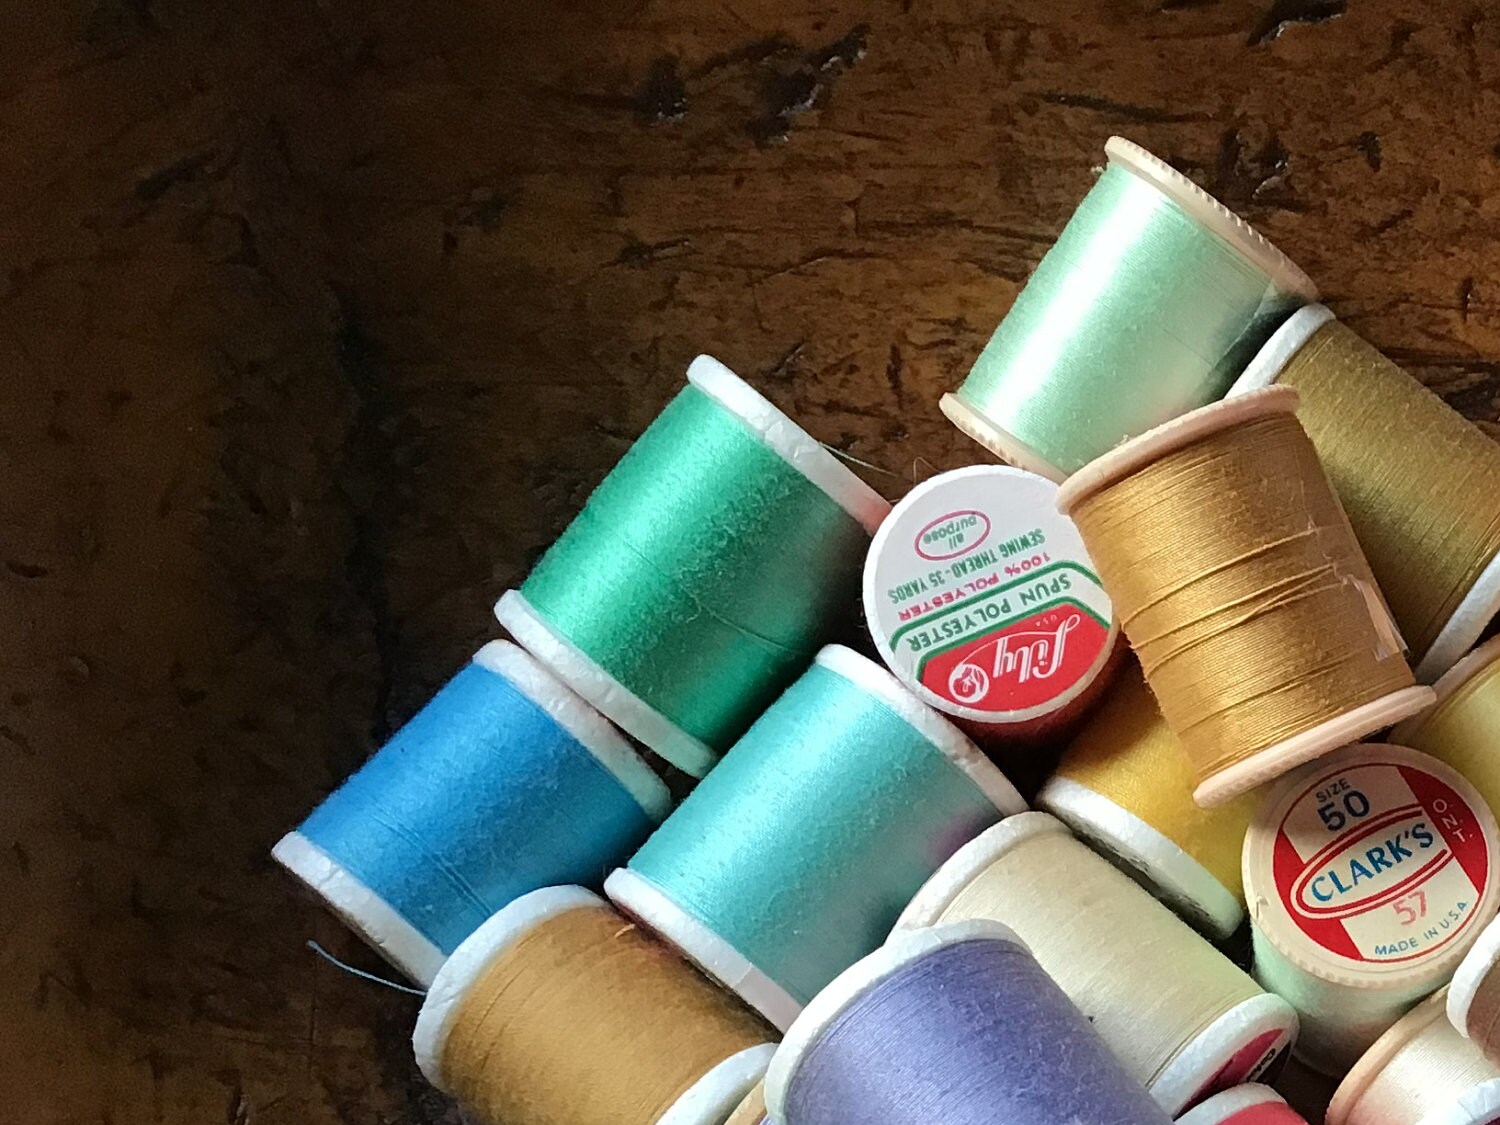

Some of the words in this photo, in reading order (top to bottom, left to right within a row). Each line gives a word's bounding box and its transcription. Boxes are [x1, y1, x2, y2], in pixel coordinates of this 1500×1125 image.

[949, 531, 965, 550] all
[999, 529, 1046, 558] SEWING
[1004, 552, 1051, 576] 100%
[888, 577, 927, 604] YARDS
[898, 573, 1000, 621] POLYESTER
[1022, 573, 1072, 606] SPUN
[906, 598, 1011, 651] POLYESTER
[1316, 777, 1351, 803] SIZE
[1317, 789, 1370, 832] 50
[1311, 823, 1434, 902] CLARK'S
[1392, 891, 1427, 926] 57
[1374, 937, 1419, 956] MADE
[1423, 927, 1439, 940] IN
